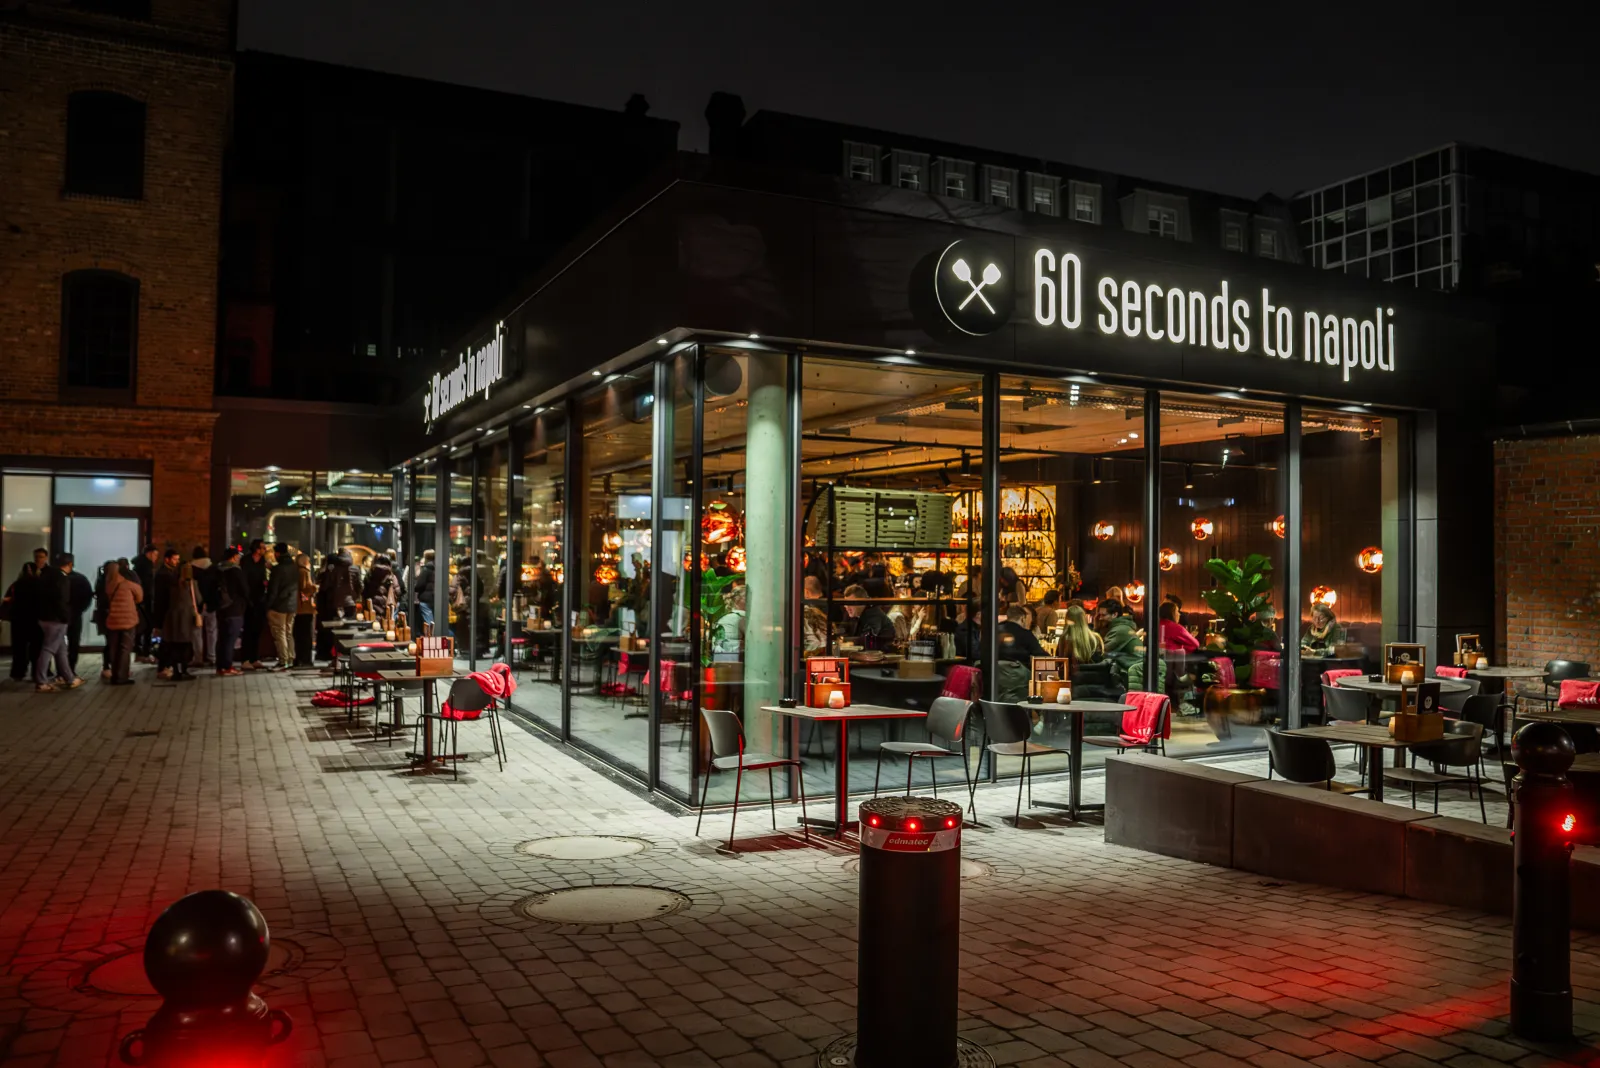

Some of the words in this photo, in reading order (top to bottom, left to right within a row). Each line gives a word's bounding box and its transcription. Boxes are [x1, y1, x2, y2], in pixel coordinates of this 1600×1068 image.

[1034, 248, 1082, 329] 60
[1097, 277, 1250, 353] seconds
[1262, 288, 1293, 359] to
[1304, 307, 1395, 382] napoli
